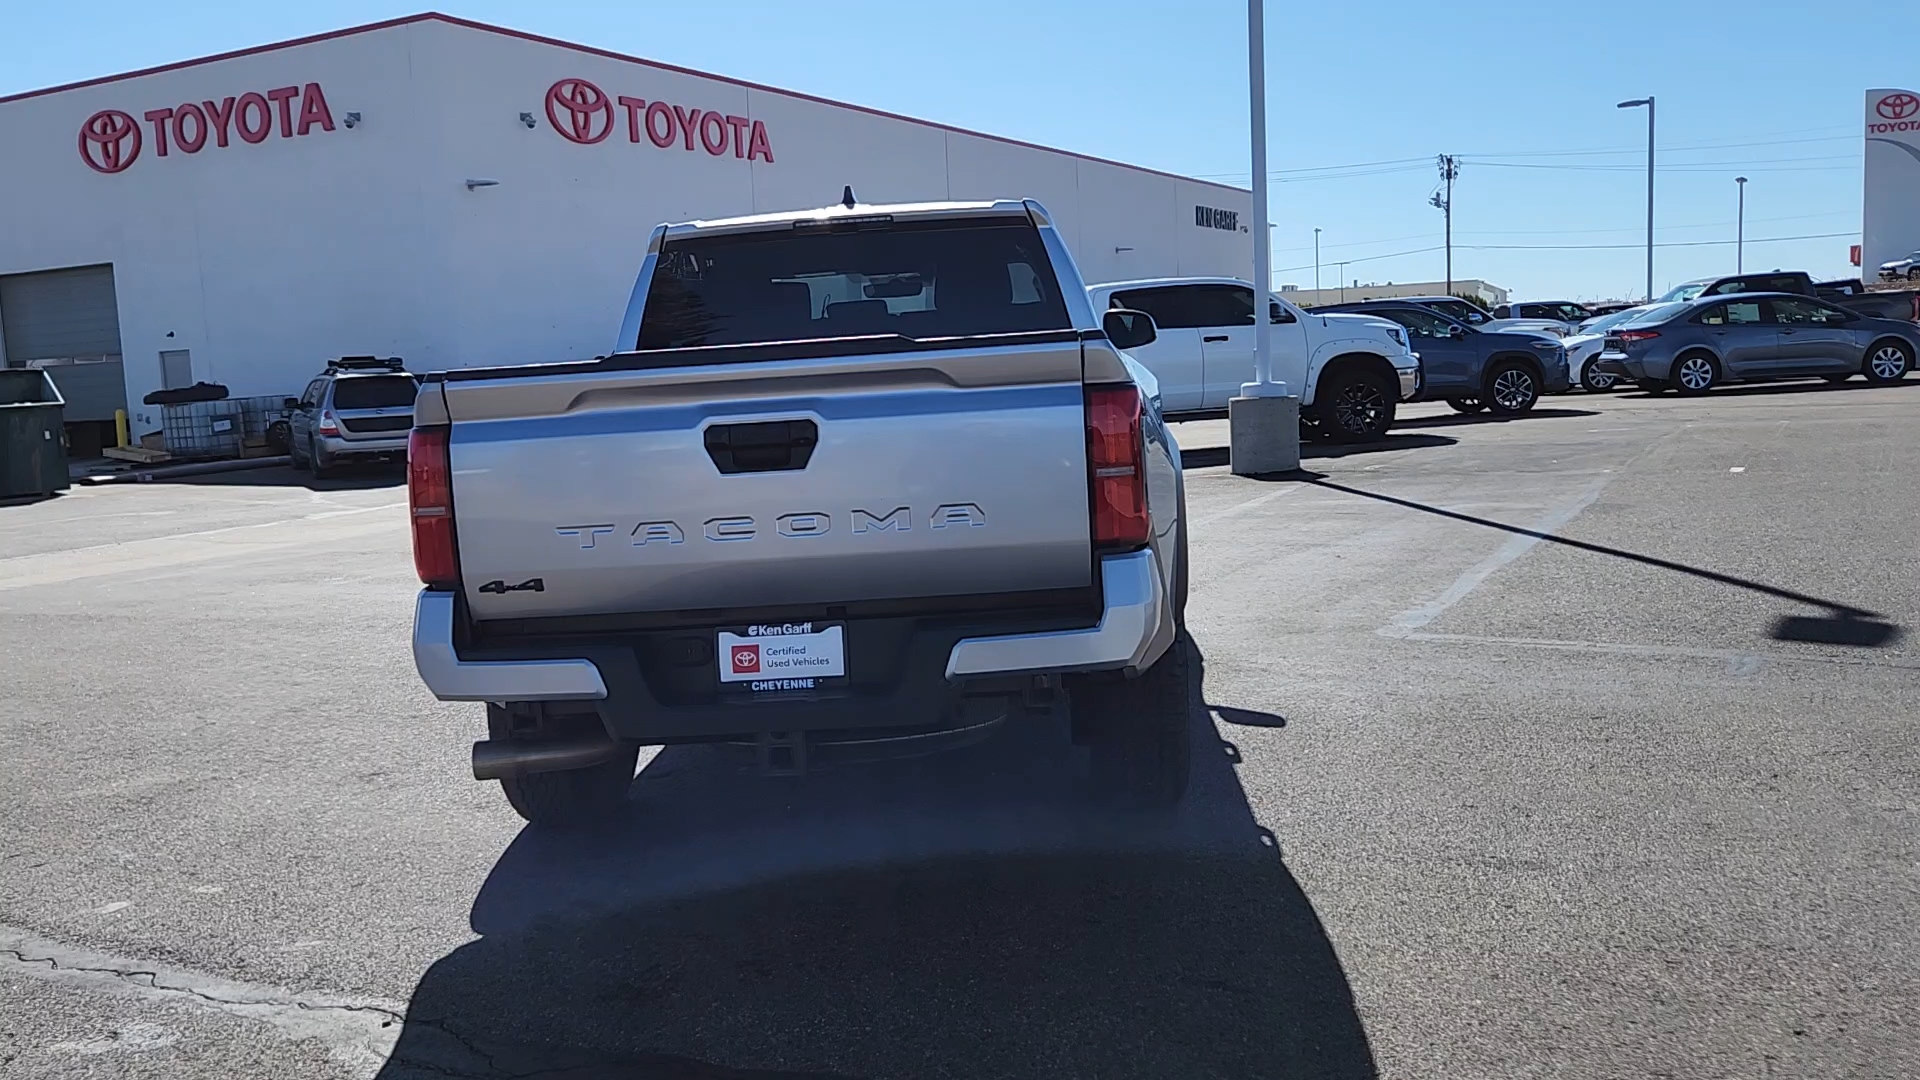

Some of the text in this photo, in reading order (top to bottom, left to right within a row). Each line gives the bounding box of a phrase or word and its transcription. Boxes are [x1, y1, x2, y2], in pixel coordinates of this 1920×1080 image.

[144, 82, 336, 157] TOYOTA
[618, 95, 774, 163] TOYOTA
[555, 503, 986, 549] TACOMA
[758, 622, 812, 635] Ken Garff
[766, 646, 806, 656] Certified
[767, 657, 830, 668] Used Vehicles
[751, 679, 815, 691] CHEYENNE
